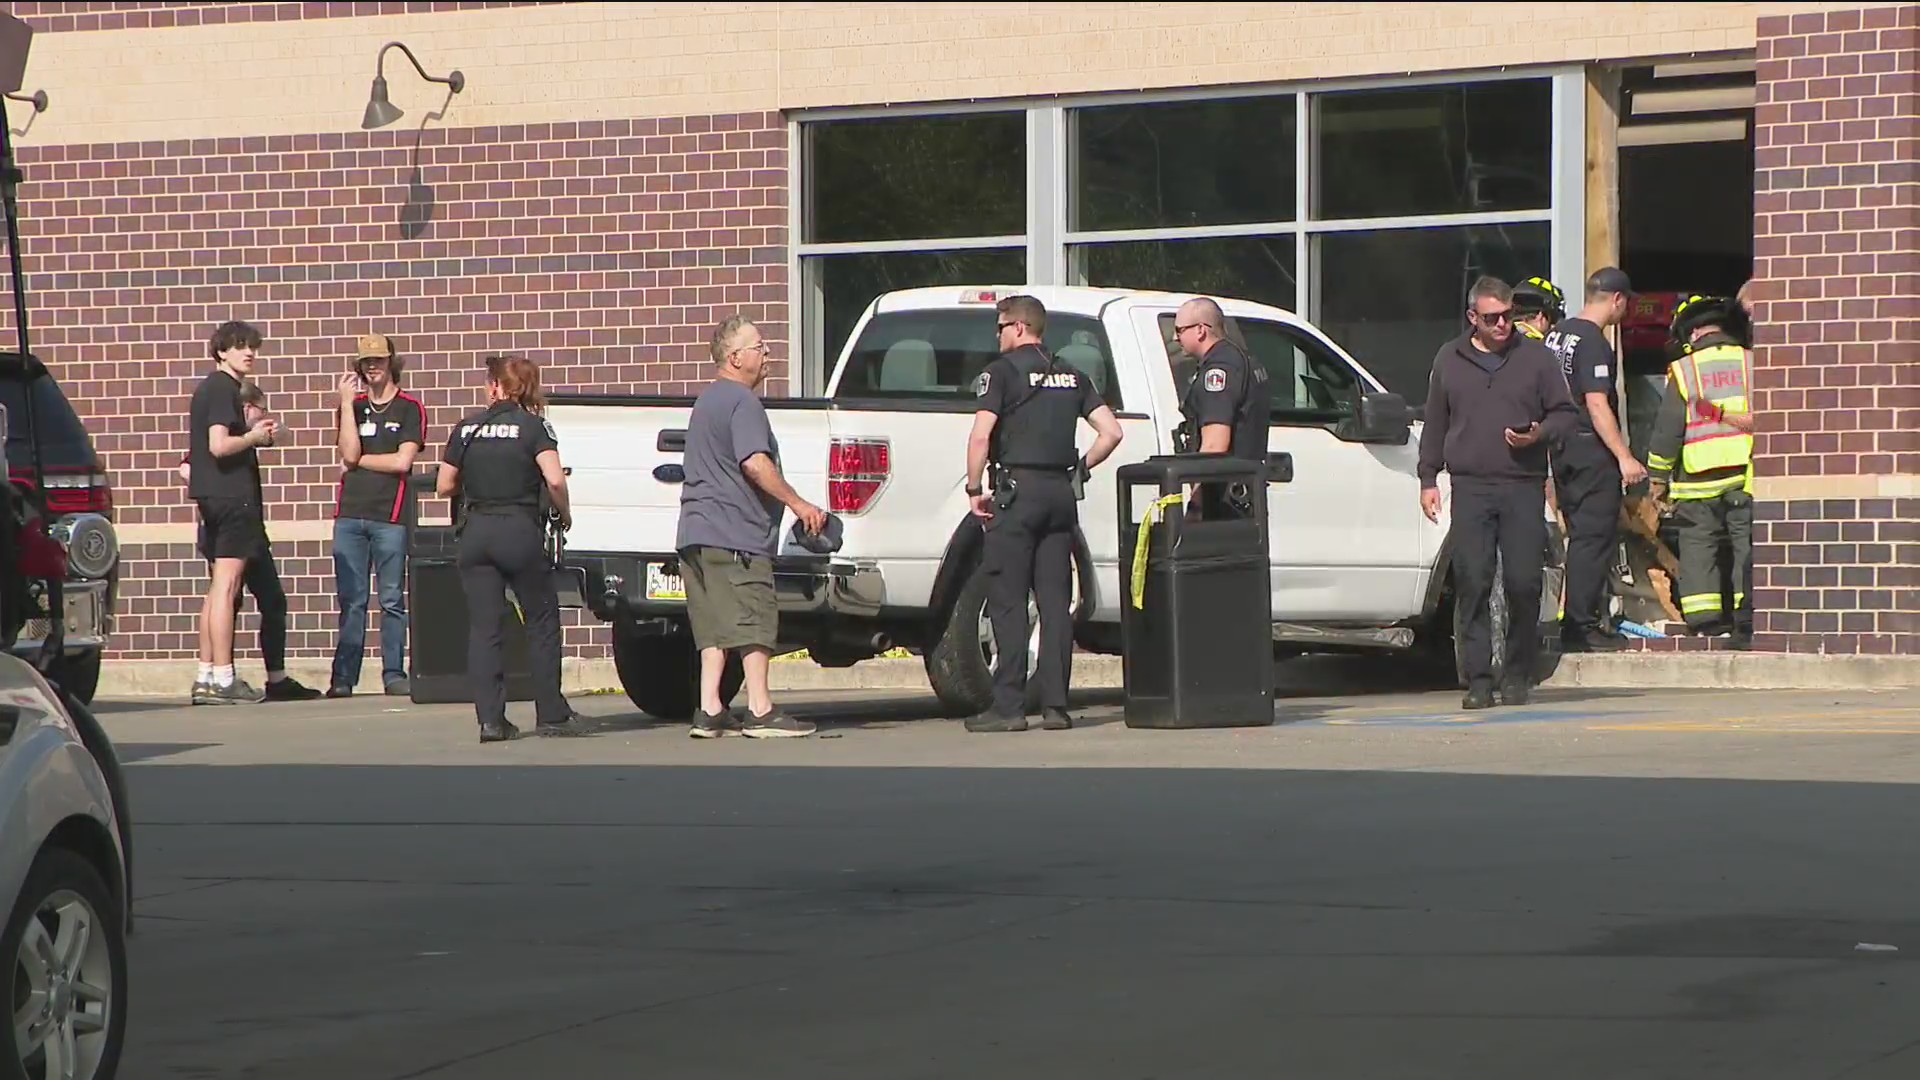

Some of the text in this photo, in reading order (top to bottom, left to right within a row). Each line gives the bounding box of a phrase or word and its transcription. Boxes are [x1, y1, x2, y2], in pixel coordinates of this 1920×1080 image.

[1029, 372, 1078, 388] POLICE
[1701, 369, 1744, 390] FIRE
[461, 424, 520, 438] POLICE
